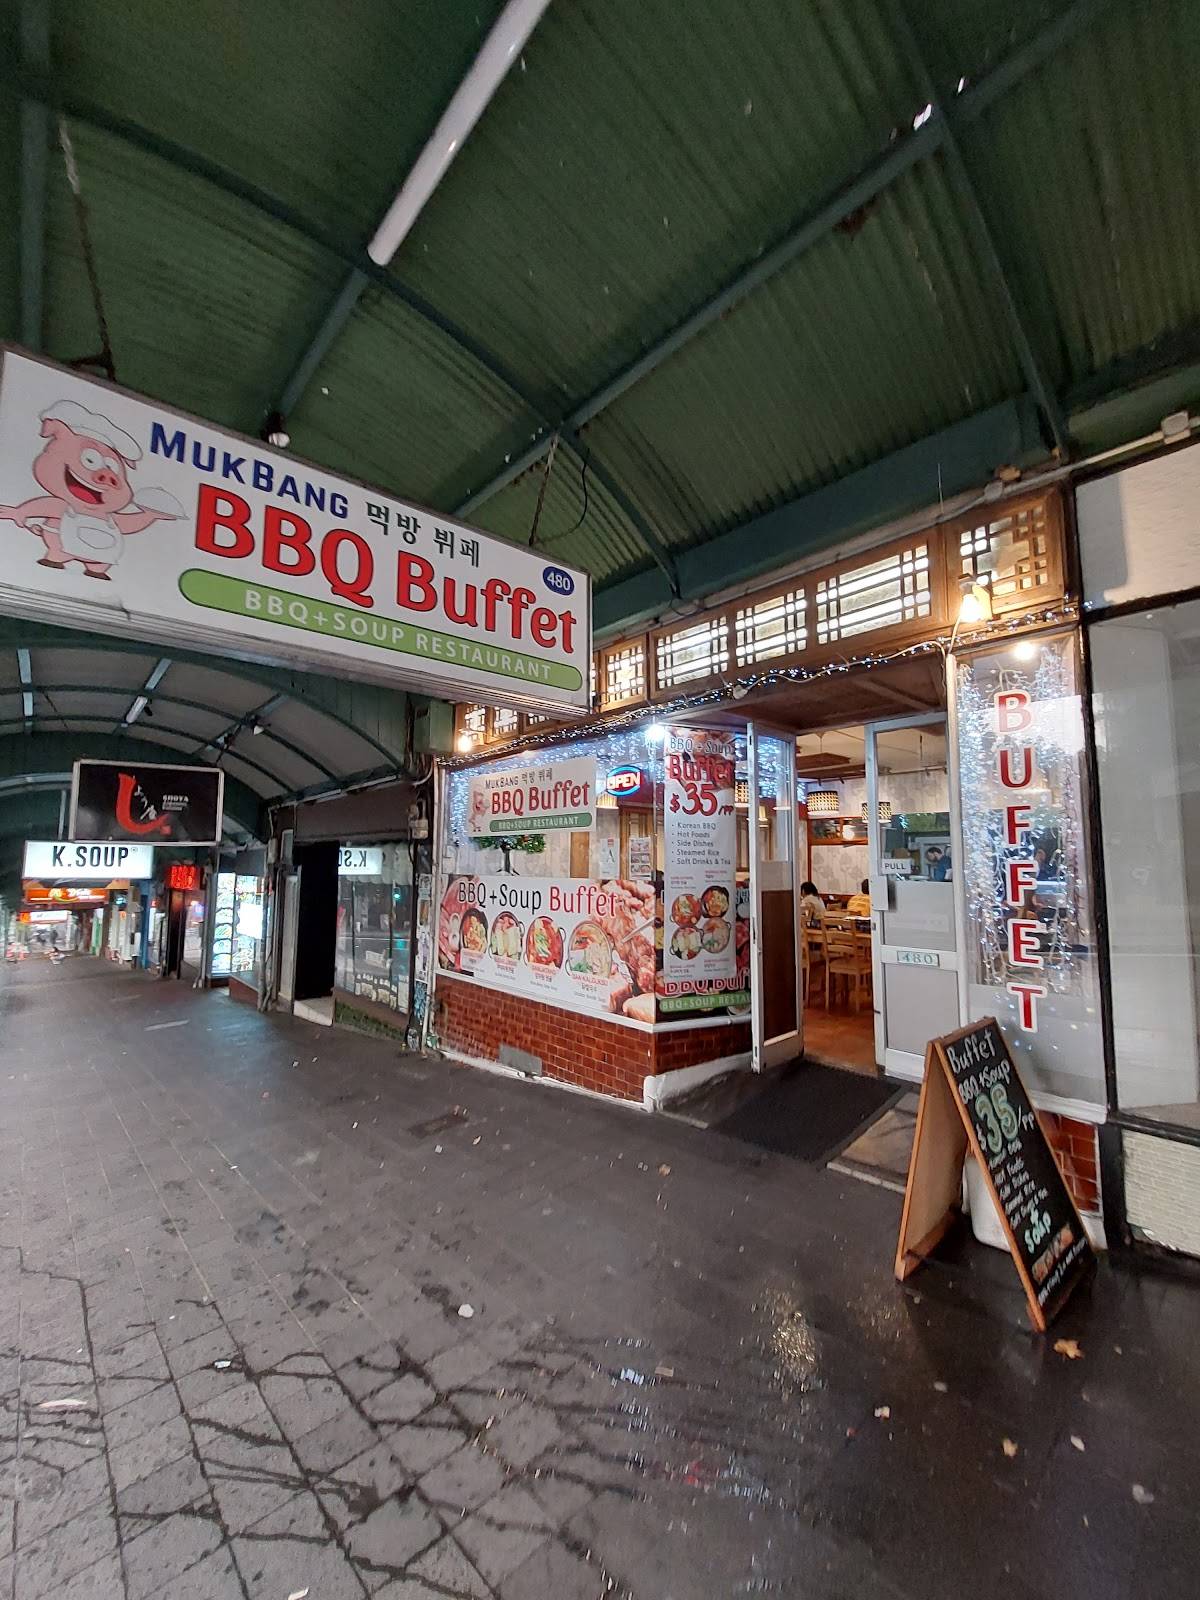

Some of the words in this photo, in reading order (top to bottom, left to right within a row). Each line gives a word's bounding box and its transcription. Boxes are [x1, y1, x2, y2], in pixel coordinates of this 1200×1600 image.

[150, 421, 349, 519] MUKBANG
[366, 501, 421, 545] 먹방
[433, 526, 480, 568] 뷔페
[194, 482, 374, 609] BBQ
[396, 550, 577, 654] Buffet
[546, 570, 572, 592] 480
[245, 589, 405, 645] BBQ+SOUP
[416, 633, 552, 680] RESTAURANT
[670, 737, 693, 752] BBQ
[705, 740, 732, 755] Soup
[607, 772, 641, 789] OPEN
[669, 755, 733, 787] Buffet
[492, 788, 524, 816] BBQ
[529, 780, 590, 811] Buffet
[533, 816, 578, 827] RESTAURANT
[52, 845, 129, 868] K.SOUP
[884, 862, 906, 870] PULL
[549, 885, 617, 917] Buffet
[901, 953, 933, 964] 480
[946, 1028, 996, 1074] Buffet
